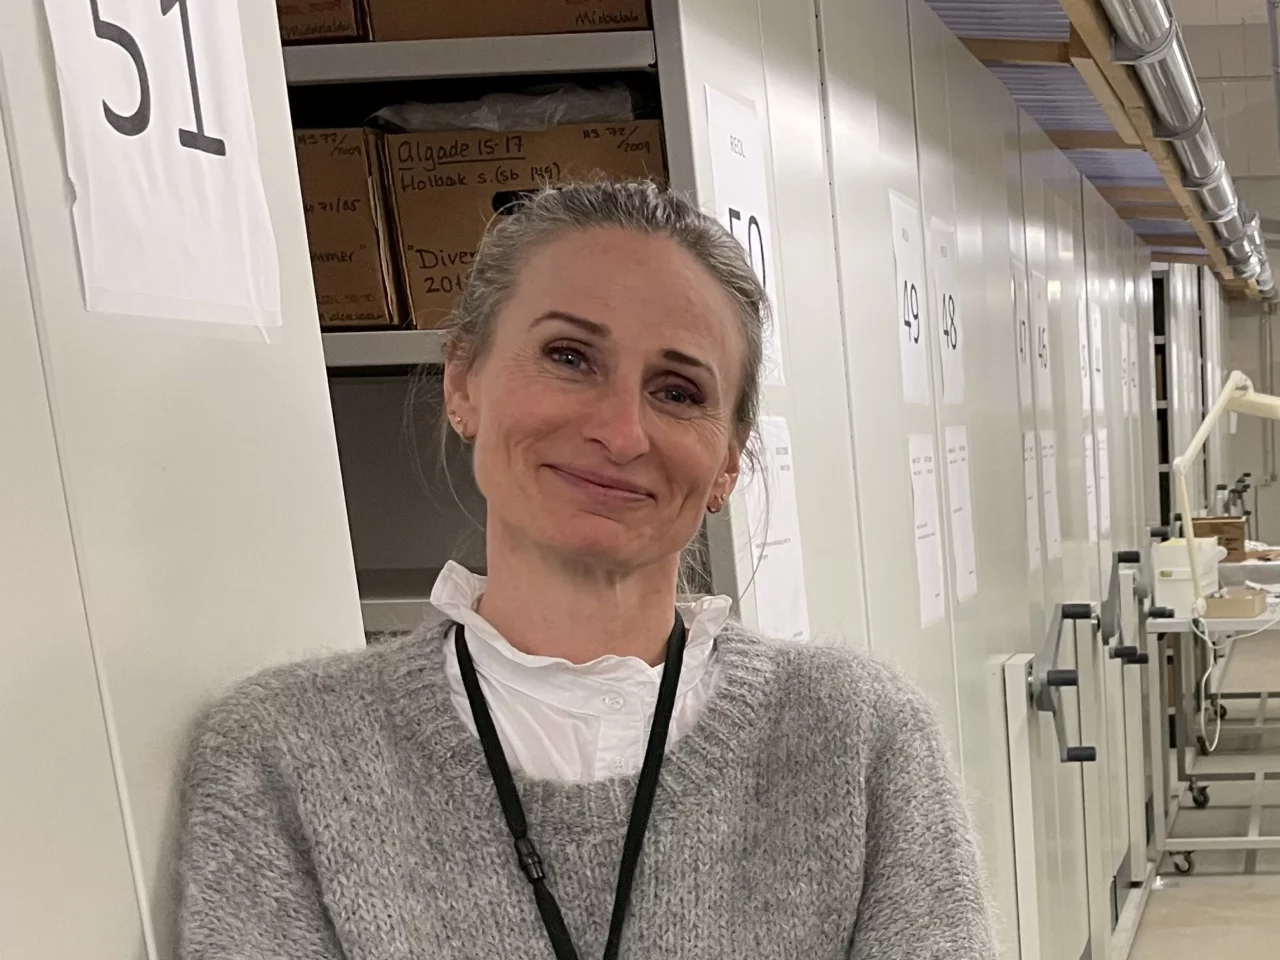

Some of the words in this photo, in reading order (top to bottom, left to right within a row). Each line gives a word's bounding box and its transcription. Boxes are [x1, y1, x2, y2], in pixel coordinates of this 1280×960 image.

[88, 0, 227, 157] 51
[903, 280, 920, 345] 49
[942, 292, 958, 351] 48
